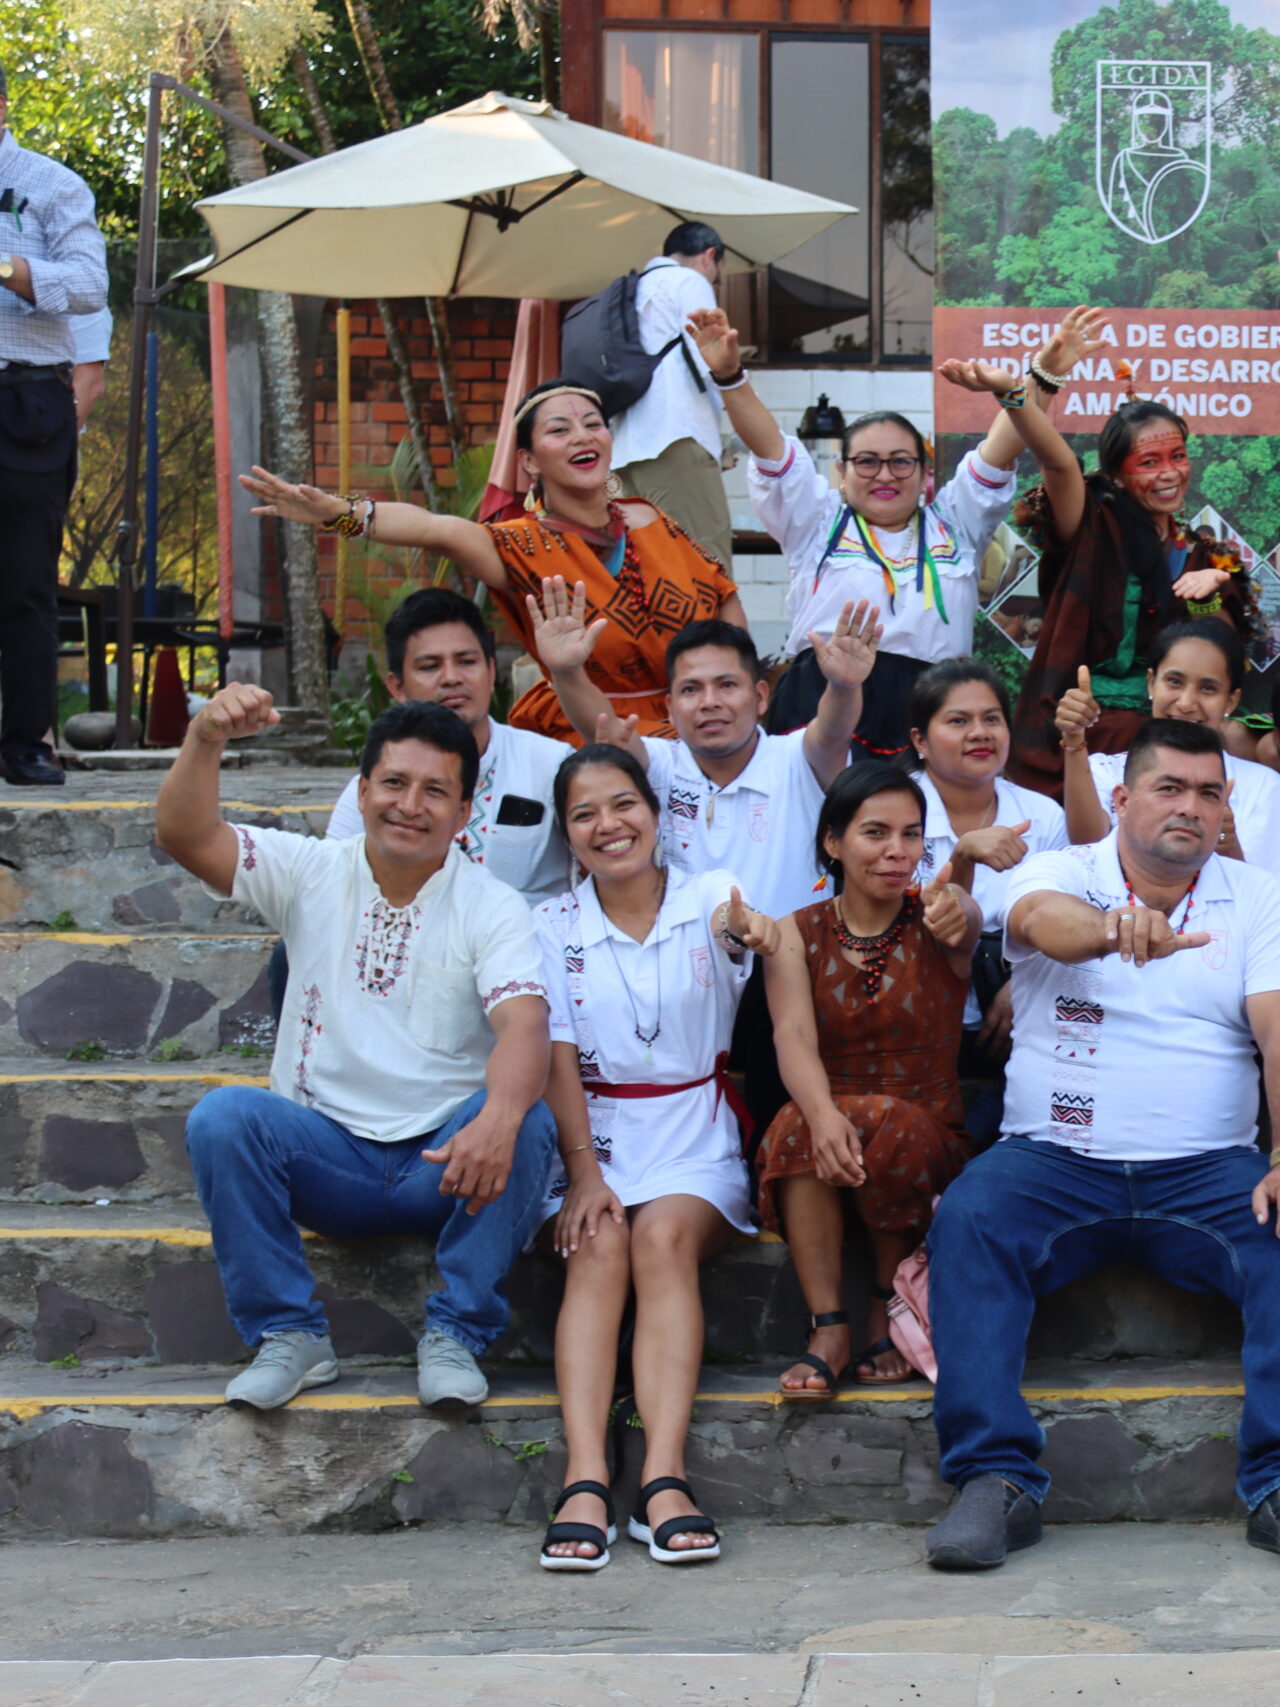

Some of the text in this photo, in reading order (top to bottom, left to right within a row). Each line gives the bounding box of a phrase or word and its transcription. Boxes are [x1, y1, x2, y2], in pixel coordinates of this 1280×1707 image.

[1109, 66, 1199, 85] EGIDA
[983, 323, 1119, 347] ESCUA
[1126, 323, 1167, 348] DE
[1119, 358, 1143, 382] Y
